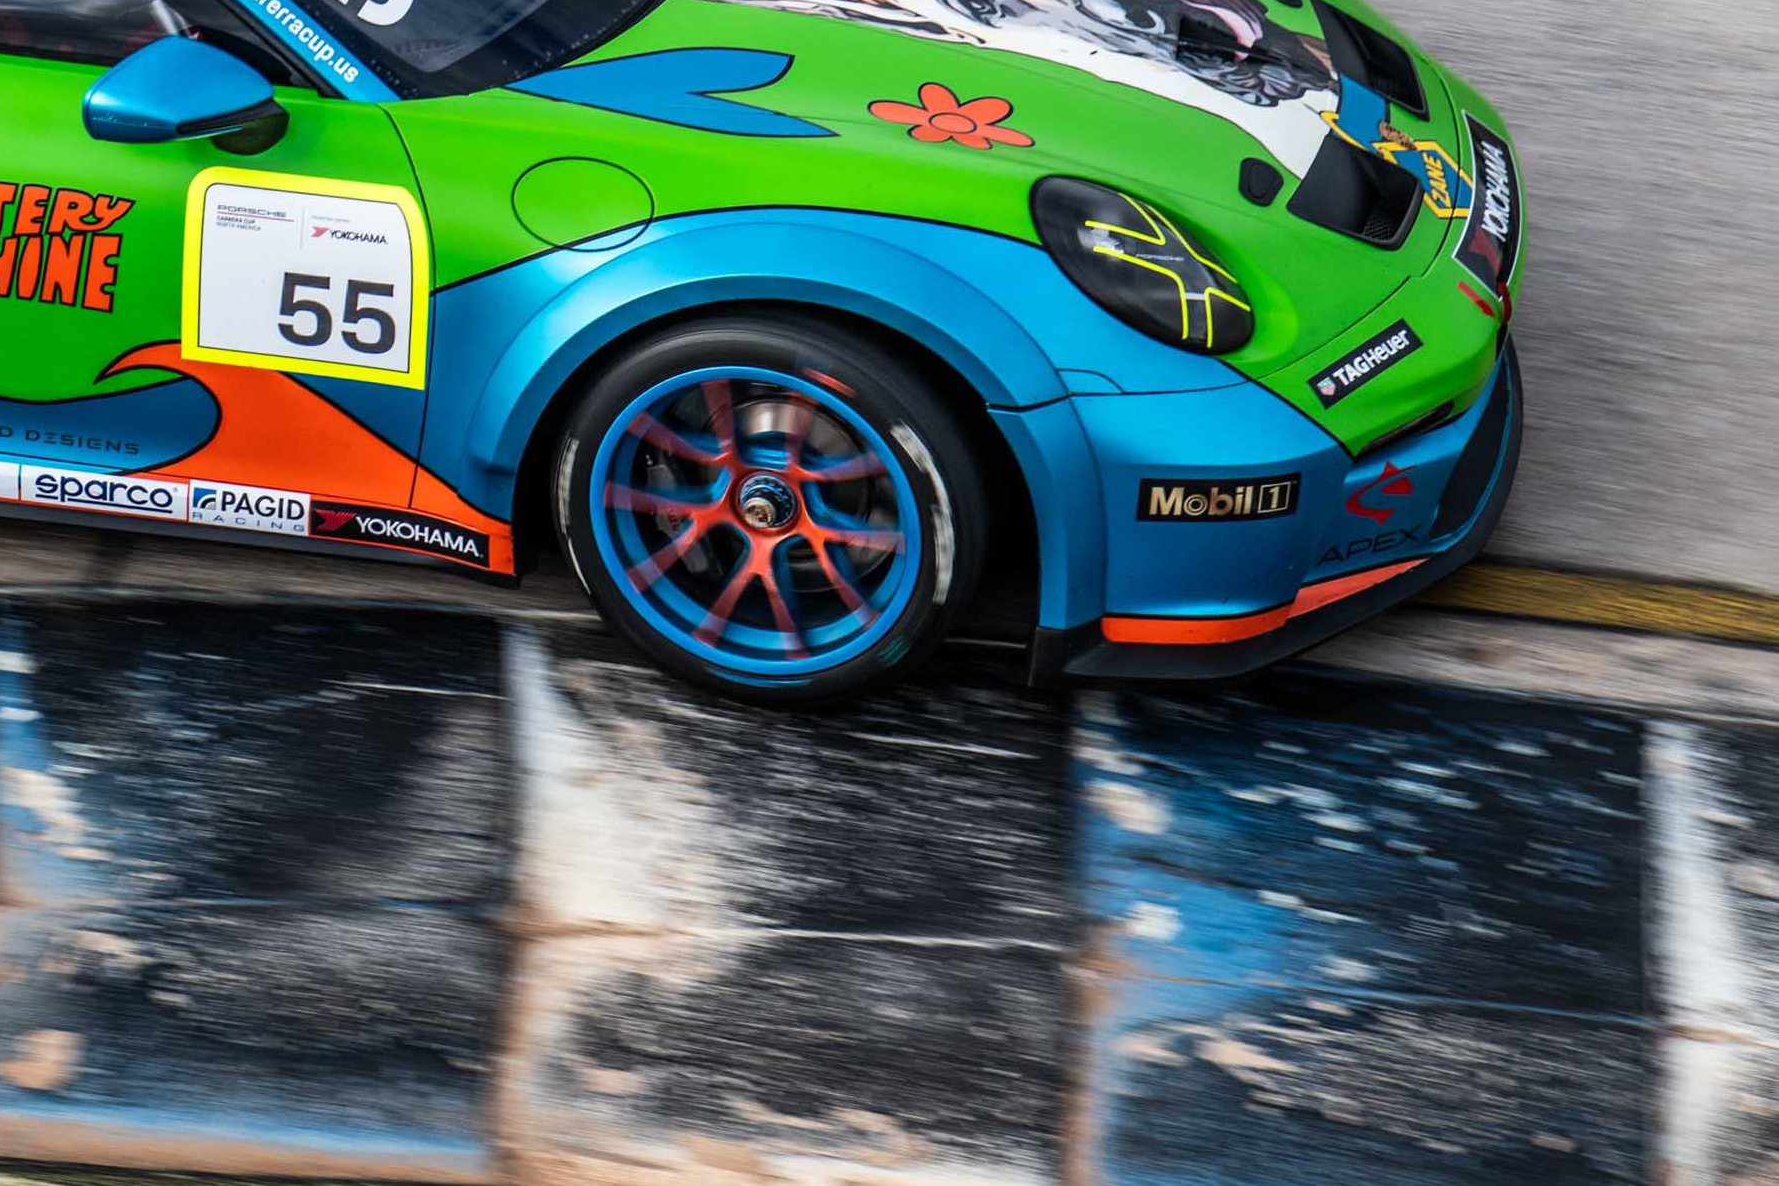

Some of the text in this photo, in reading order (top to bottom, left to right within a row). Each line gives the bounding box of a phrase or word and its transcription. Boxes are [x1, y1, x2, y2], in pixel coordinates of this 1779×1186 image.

[1422, 151, 1452, 208] ZANE
[1481, 140, 1511, 243] YOKOHAMA
[217, 204, 287, 218] PORSCHE
[330, 229, 388, 245] YOKOHAMA
[278, 272, 396, 354] 55
[35, 473, 173, 510] sparco
[221, 490, 305, 521] PAGID
[1148, 485, 1254, 516] Mobil
[192, 512, 305, 533] RACING
[355, 515, 480, 558] YOKOHAMA
[1317, 524, 1423, 566] APEX
